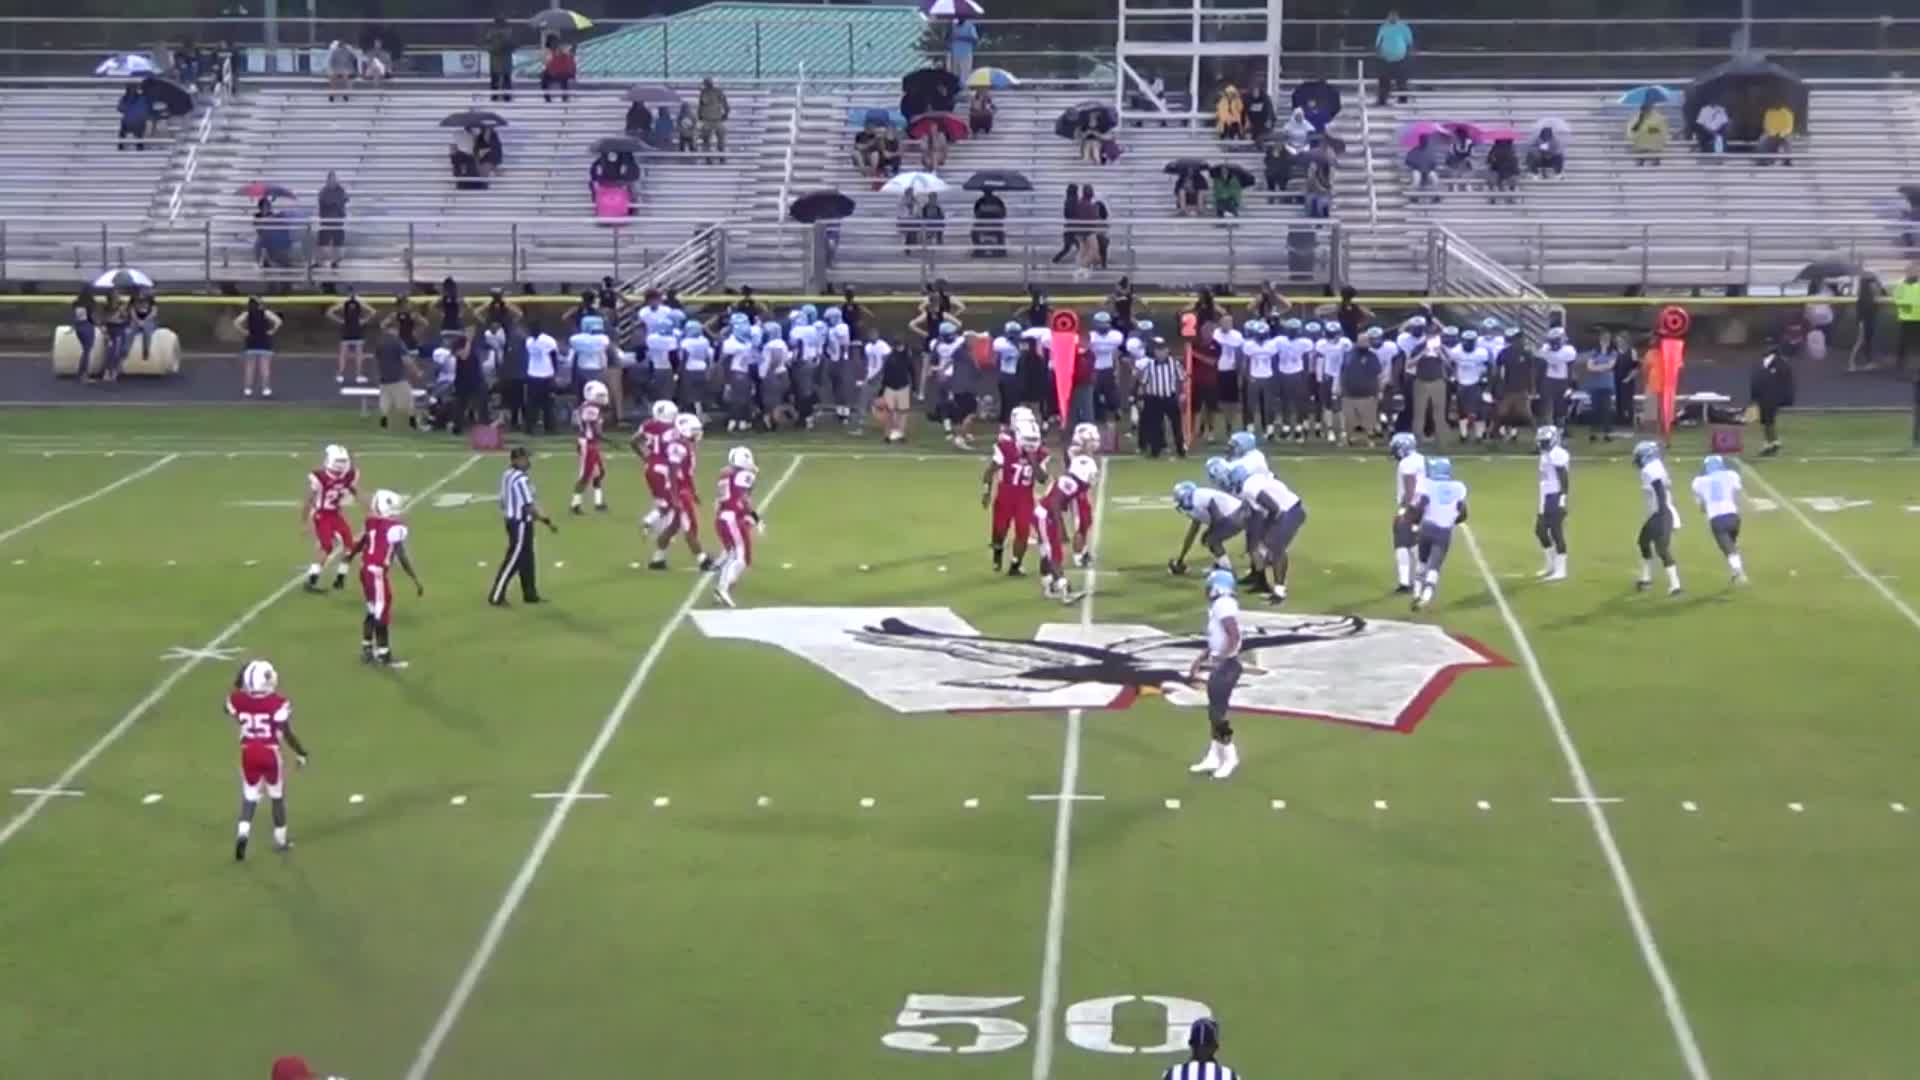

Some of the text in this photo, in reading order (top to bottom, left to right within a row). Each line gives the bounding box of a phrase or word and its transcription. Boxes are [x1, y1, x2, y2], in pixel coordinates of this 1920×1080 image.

[1181, 312, 1197, 336] 2
[1011, 463, 1033, 486] 79
[238, 713, 273, 738] 25
[881, 993, 1212, 1055] 50
